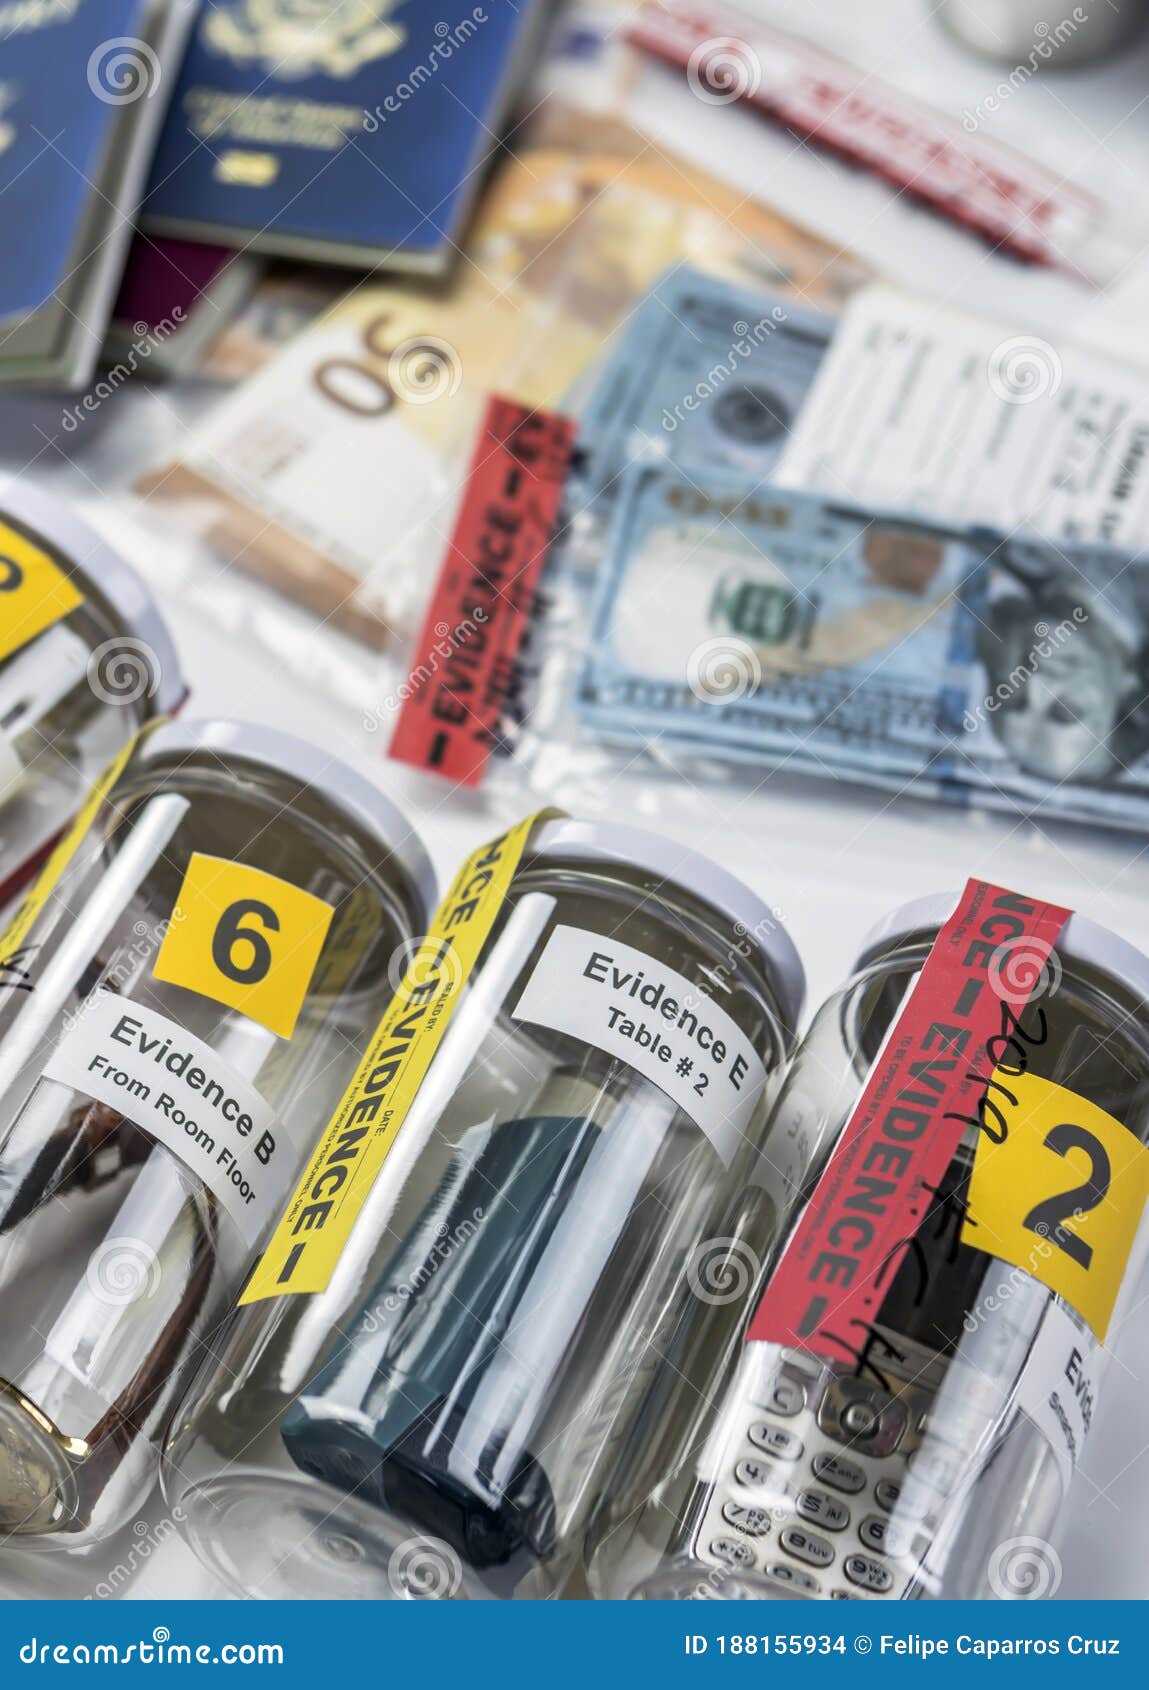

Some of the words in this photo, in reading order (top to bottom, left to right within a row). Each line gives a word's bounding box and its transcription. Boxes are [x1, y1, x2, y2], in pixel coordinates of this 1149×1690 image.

[432, 505, 525, 727] EVIDENCE
[211, 898, 280, 985] 6
[110, 1014, 254, 1138] Evidence
[254, 1130, 277, 1166] B
[582, 952, 727, 1064] Evidence
[728, 1054, 749, 1091] E
[607, 1006, 673, 1063] Table
[675, 1056, 694, 1078] #
[692, 1073, 710, 1097] 2
[88, 1054, 151, 1102] From
[154, 1093, 217, 1155] Room
[216, 1147, 257, 1204] Floor
[290, 978, 441, 1236] EVIDENCE
[375, 1109, 395, 1137] DATE:
[807, 1022, 973, 1289] EVIDENCE
[1022, 1123, 1112, 1272] 2
